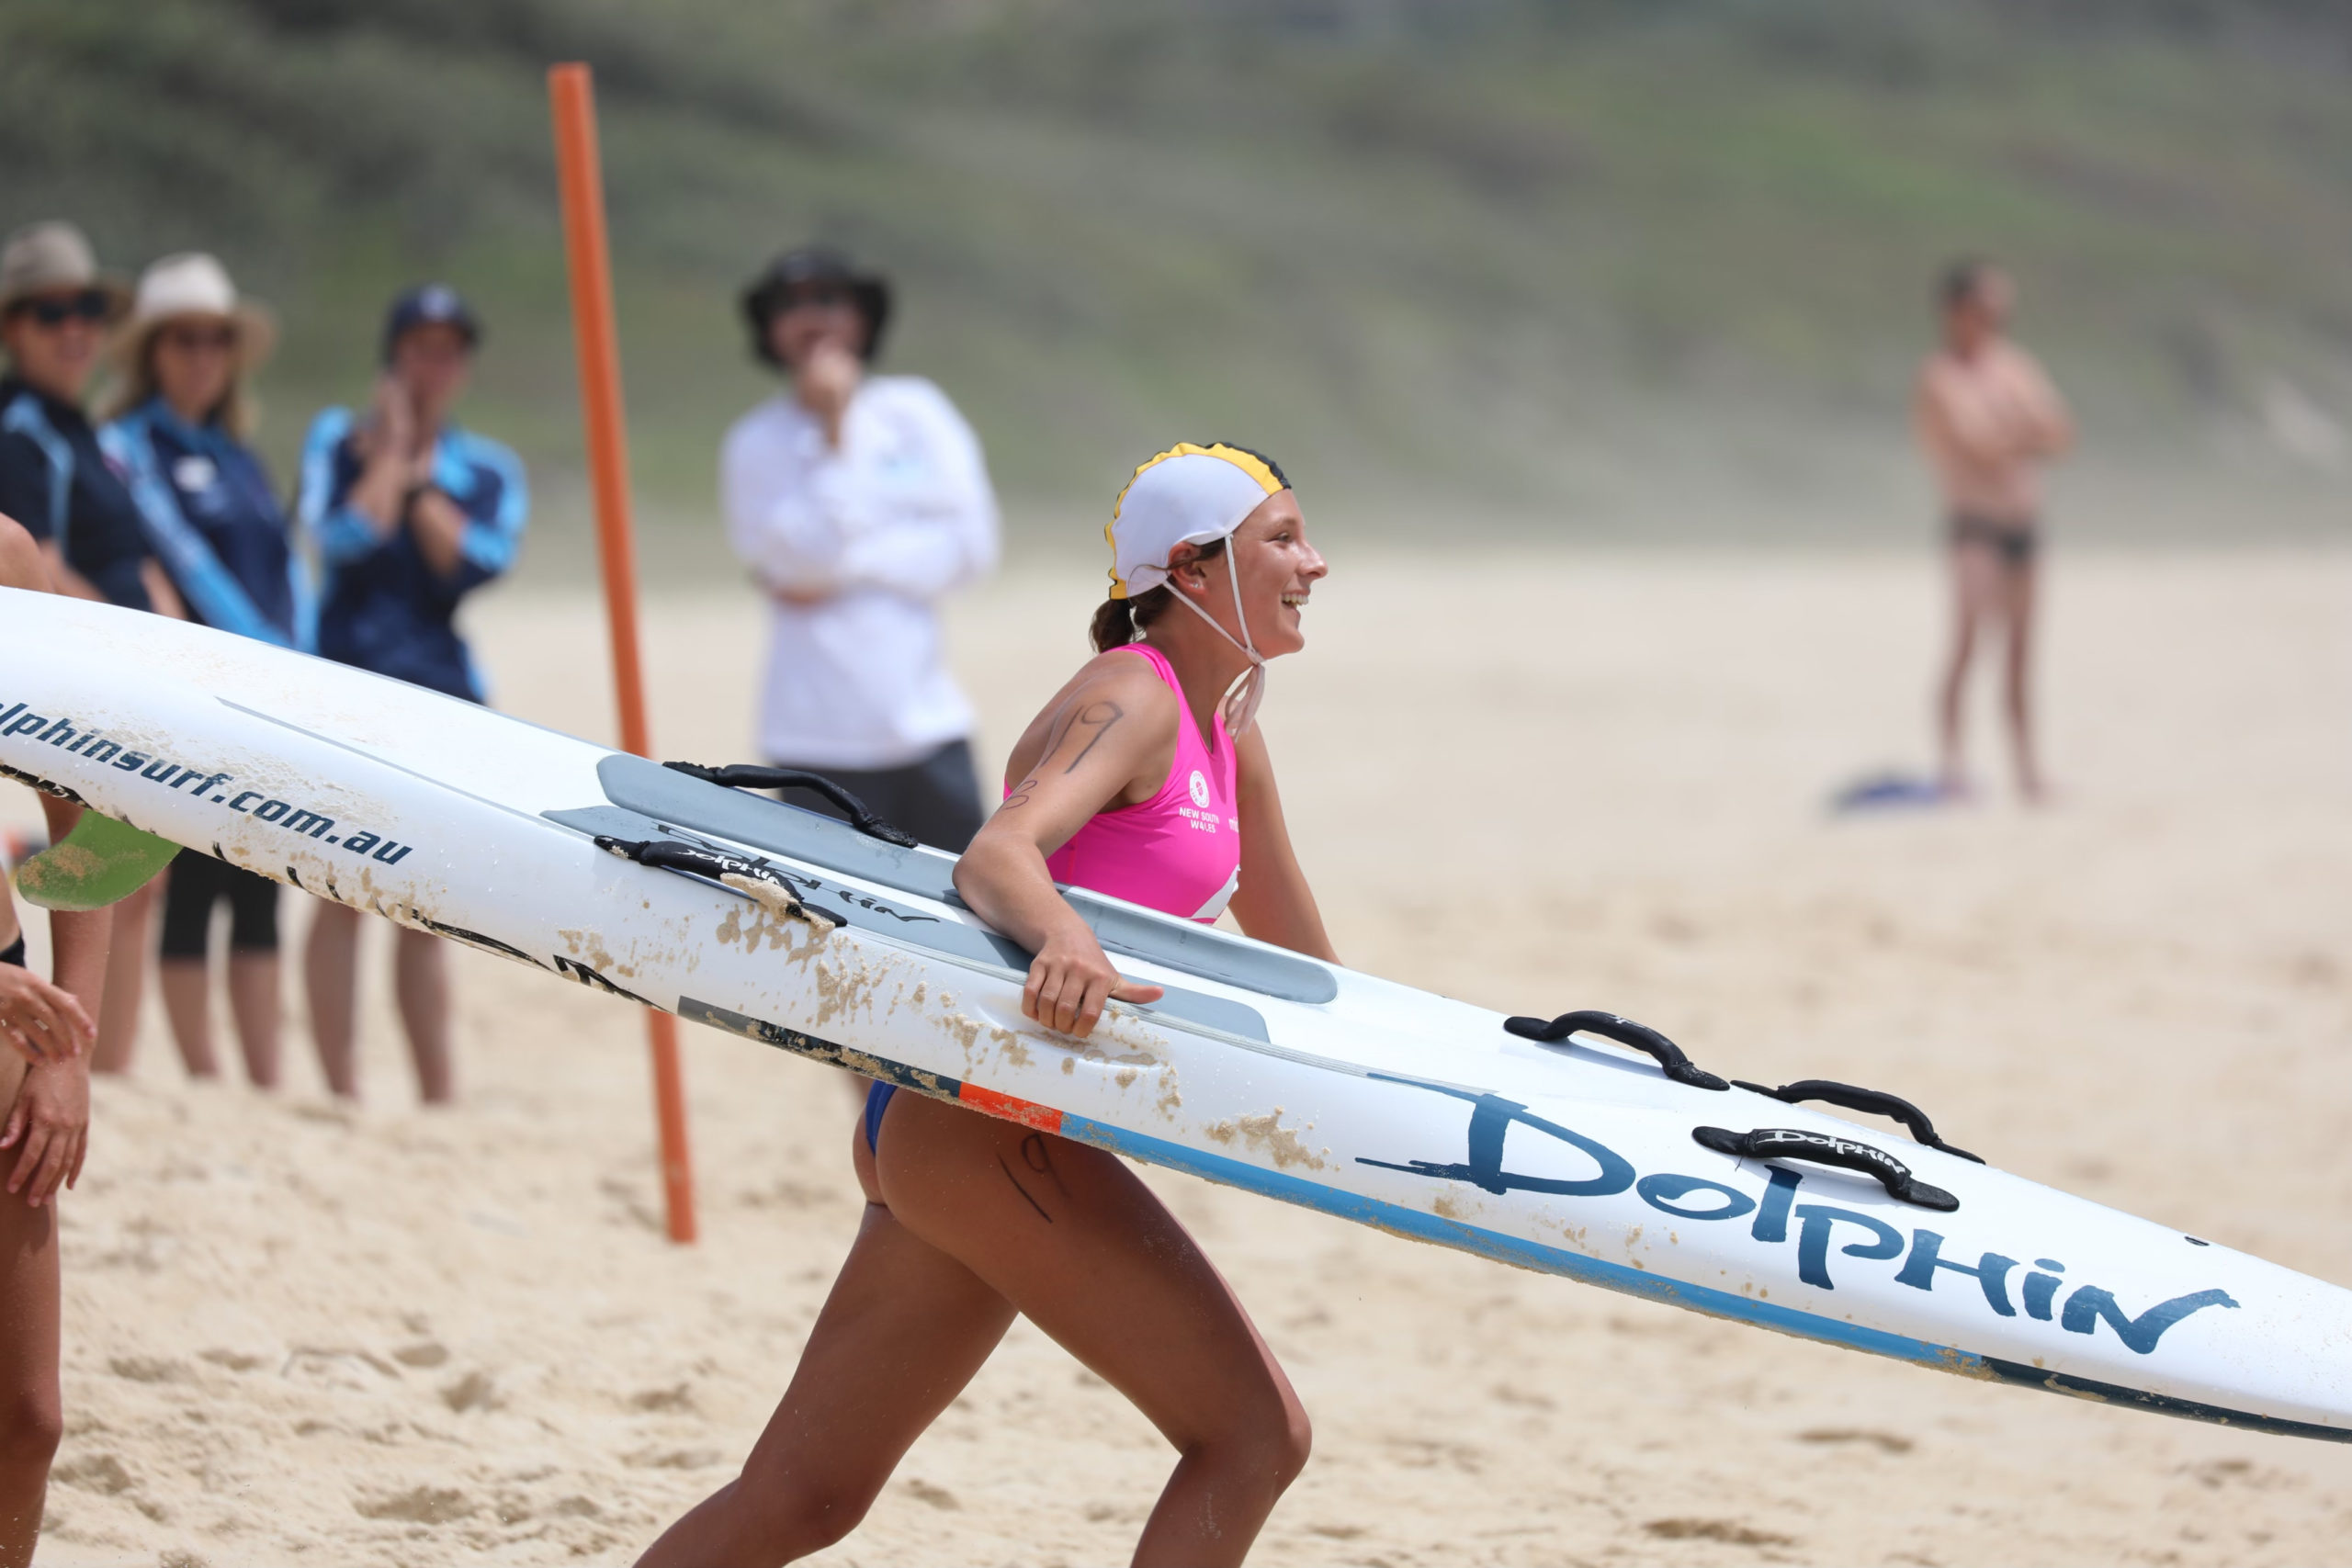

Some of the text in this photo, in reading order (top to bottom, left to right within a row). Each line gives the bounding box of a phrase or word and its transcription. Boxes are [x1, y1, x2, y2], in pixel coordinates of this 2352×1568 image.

[0, 702, 413, 865] lphinsurf.com.au
[1179, 807, 1220, 824] NEW SOUTH
[1190, 819, 1216, 834] WALES
